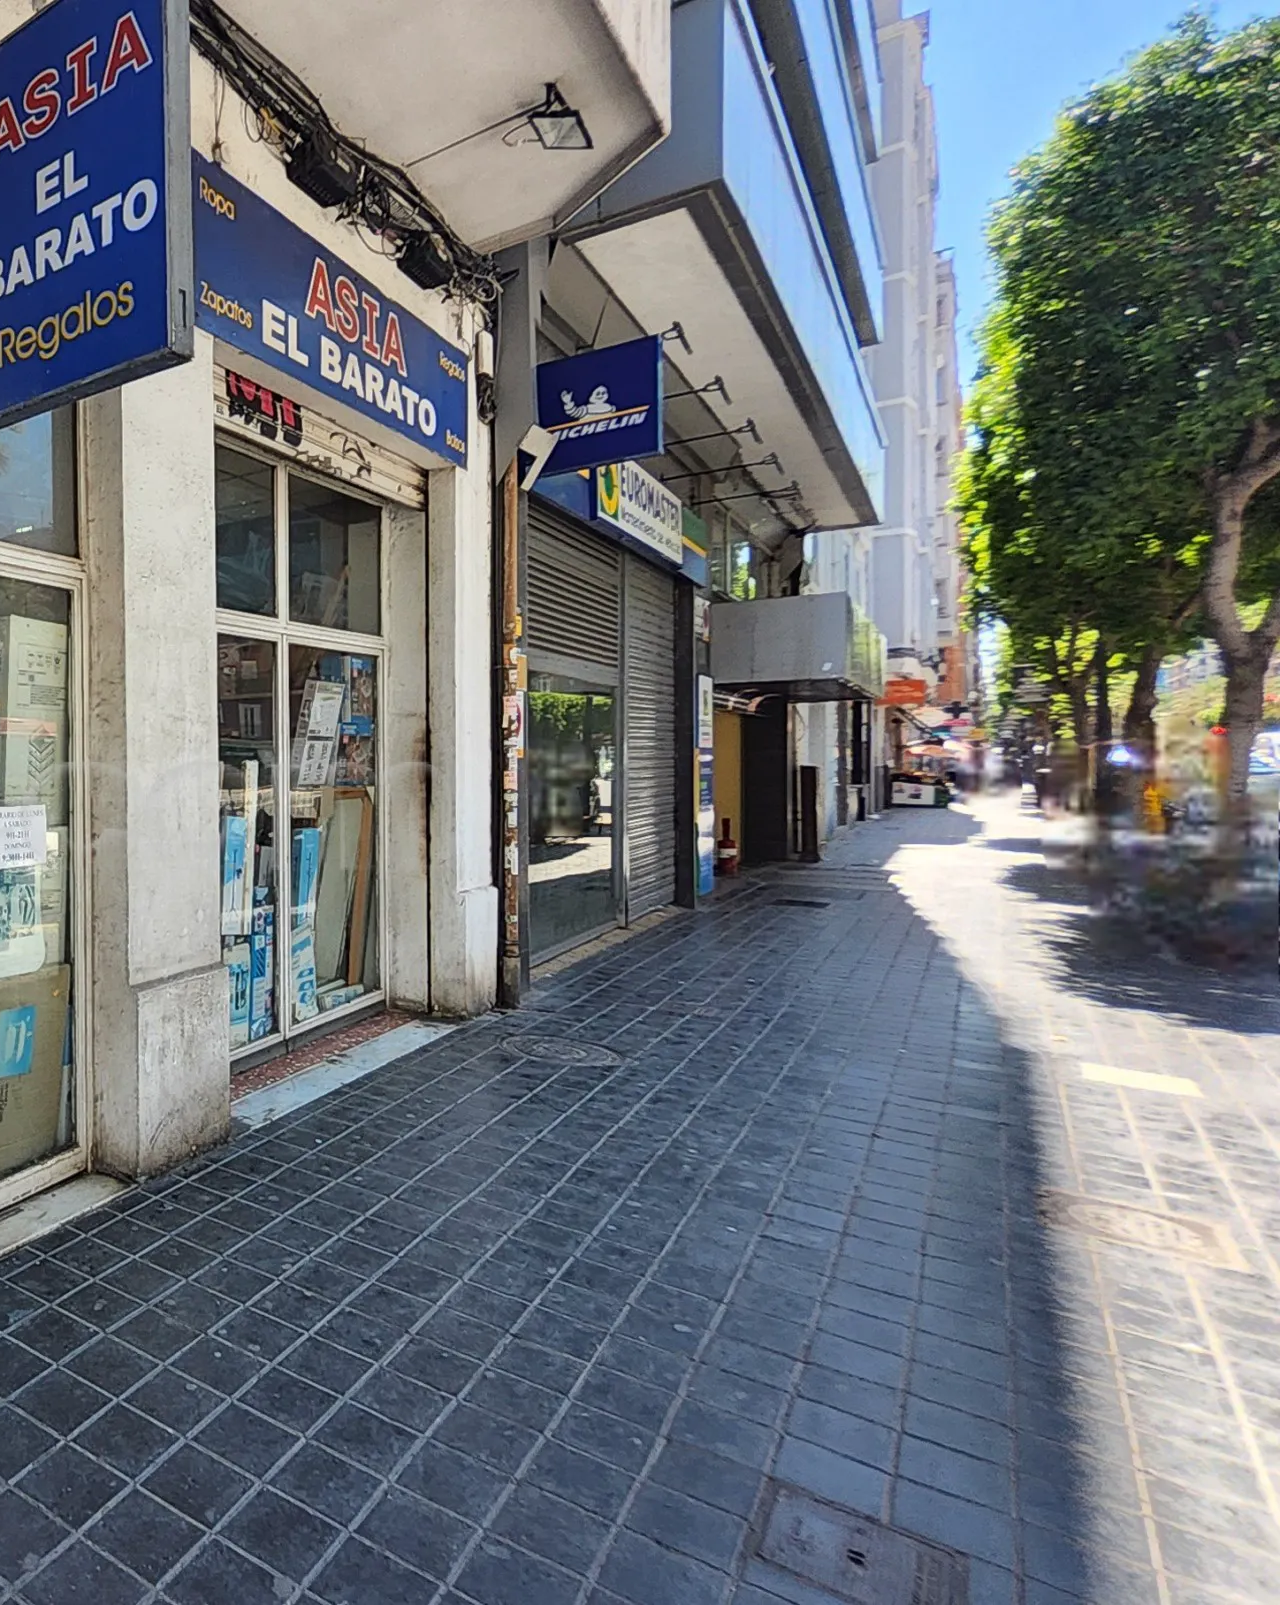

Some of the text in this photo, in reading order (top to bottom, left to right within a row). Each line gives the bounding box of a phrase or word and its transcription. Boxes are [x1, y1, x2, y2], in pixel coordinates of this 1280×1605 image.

[36, 151, 89, 215] EL
[199, 176, 236, 221] Ropa
[200, 281, 253, 329] Zapatos
[305, 257, 408, 378] ASIA
[262, 298, 309, 368] EL
[320, 334, 437, 437] BARATO
